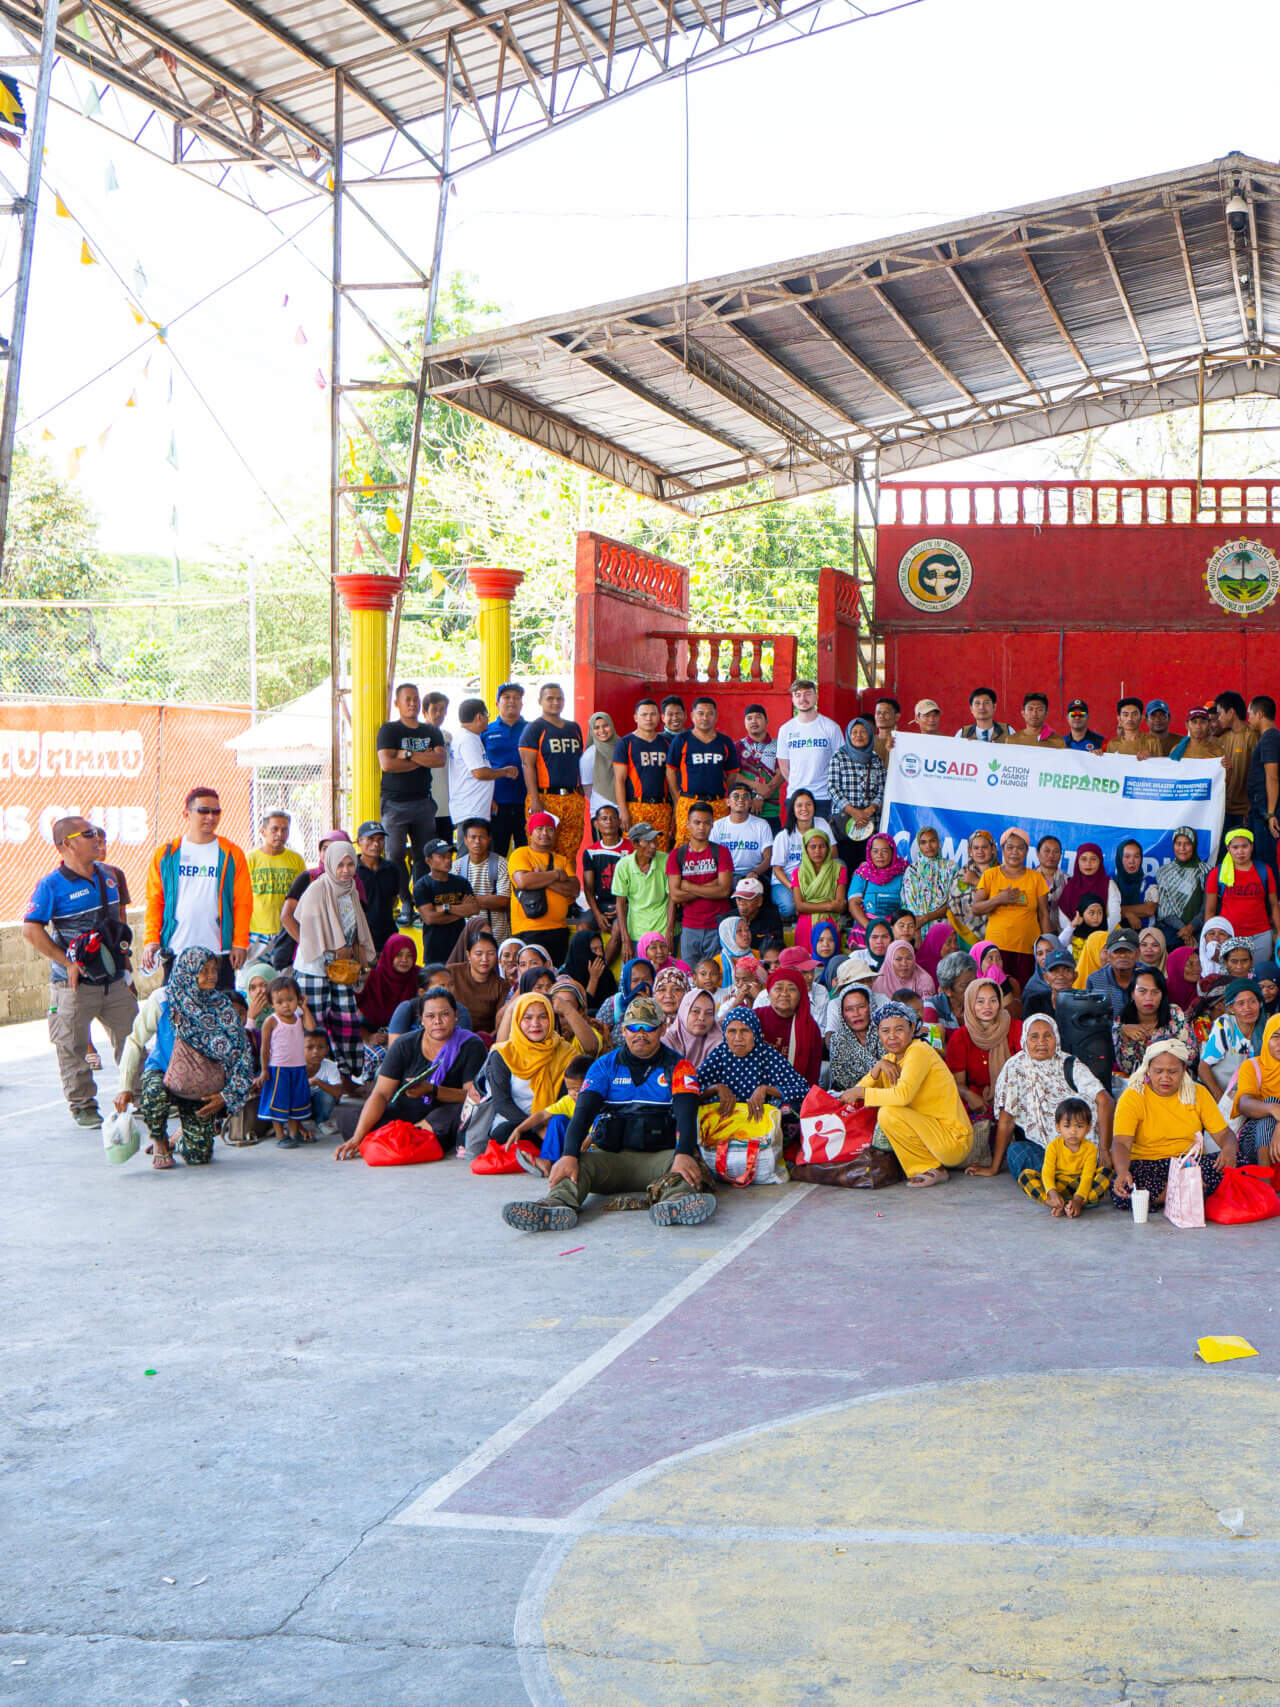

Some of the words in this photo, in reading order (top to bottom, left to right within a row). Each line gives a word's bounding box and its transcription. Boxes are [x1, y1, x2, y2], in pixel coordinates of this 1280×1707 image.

[1209, 544, 1235, 589] MUNICIPALITY
[1252, 543, 1272, 559] DATU
[1269, 560, 1280, 588] PIANG
[549, 738, 580, 753] BFP
[640, 751, 666, 766] BFP
[692, 753, 723, 764] BFP
[924, 759, 978, 776] USAID
[1002, 766, 1030, 774] ACTION
[1000, 779, 1028, 787] HUNGER
